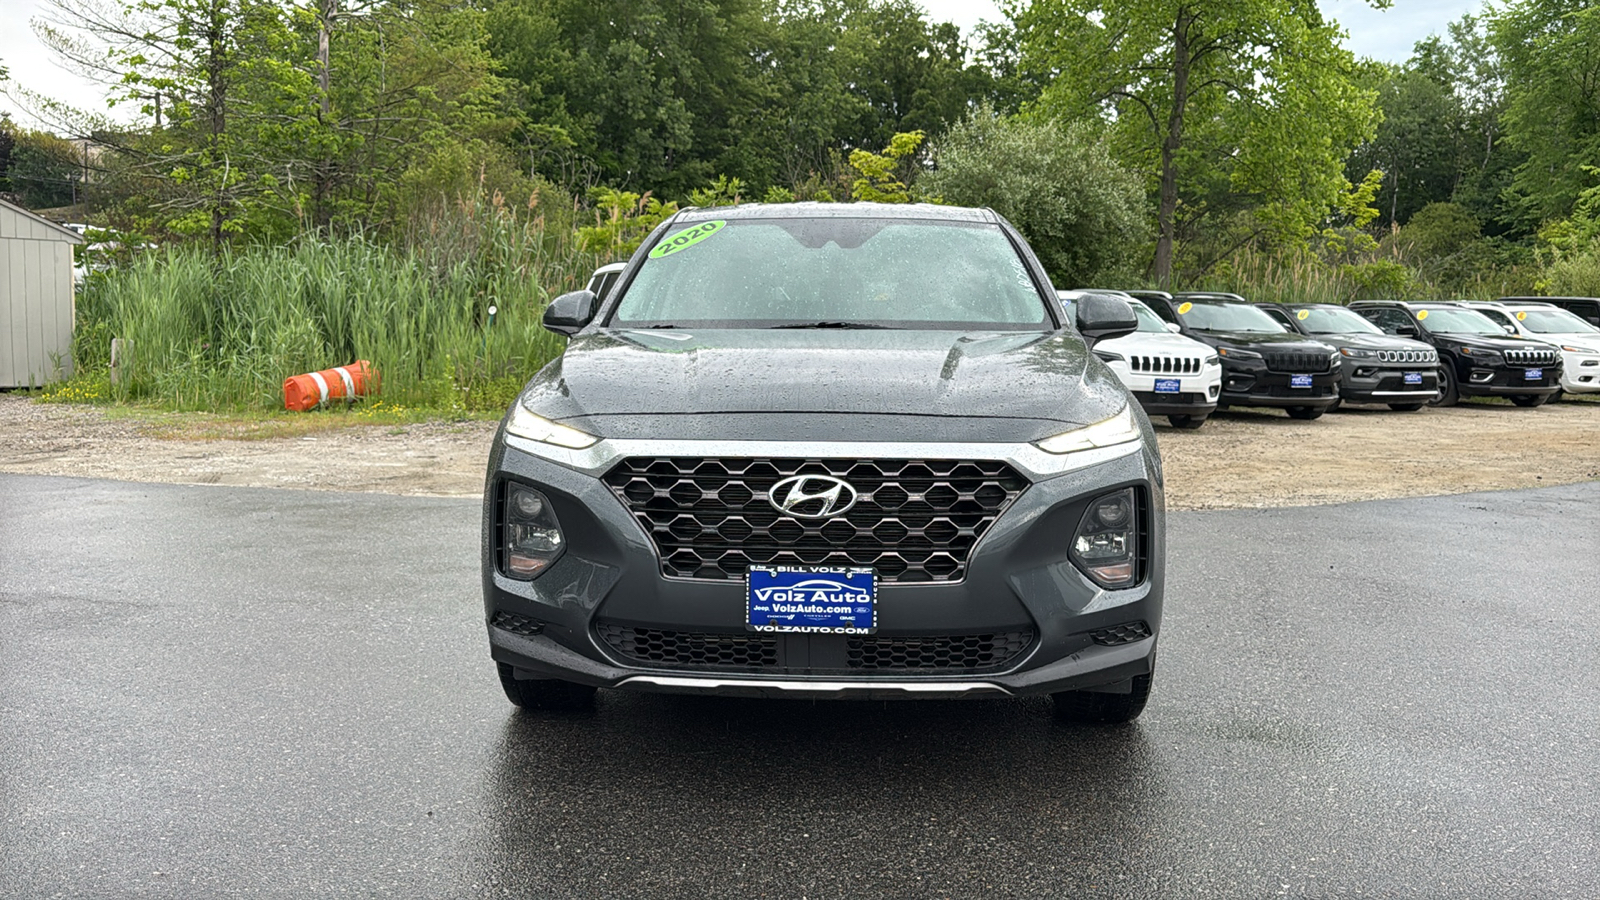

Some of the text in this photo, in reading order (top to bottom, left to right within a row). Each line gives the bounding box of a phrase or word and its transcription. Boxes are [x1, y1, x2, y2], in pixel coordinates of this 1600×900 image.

[658, 222, 717, 254] 2020
[809, 566, 846, 574] VOLZ
[754, 589, 871, 603] Volz Auto
[753, 604, 770, 612] Jeep
[772, 603, 852, 614] VolzAuto.com
[754, 625, 869, 635] VOLZAUTO.COM
